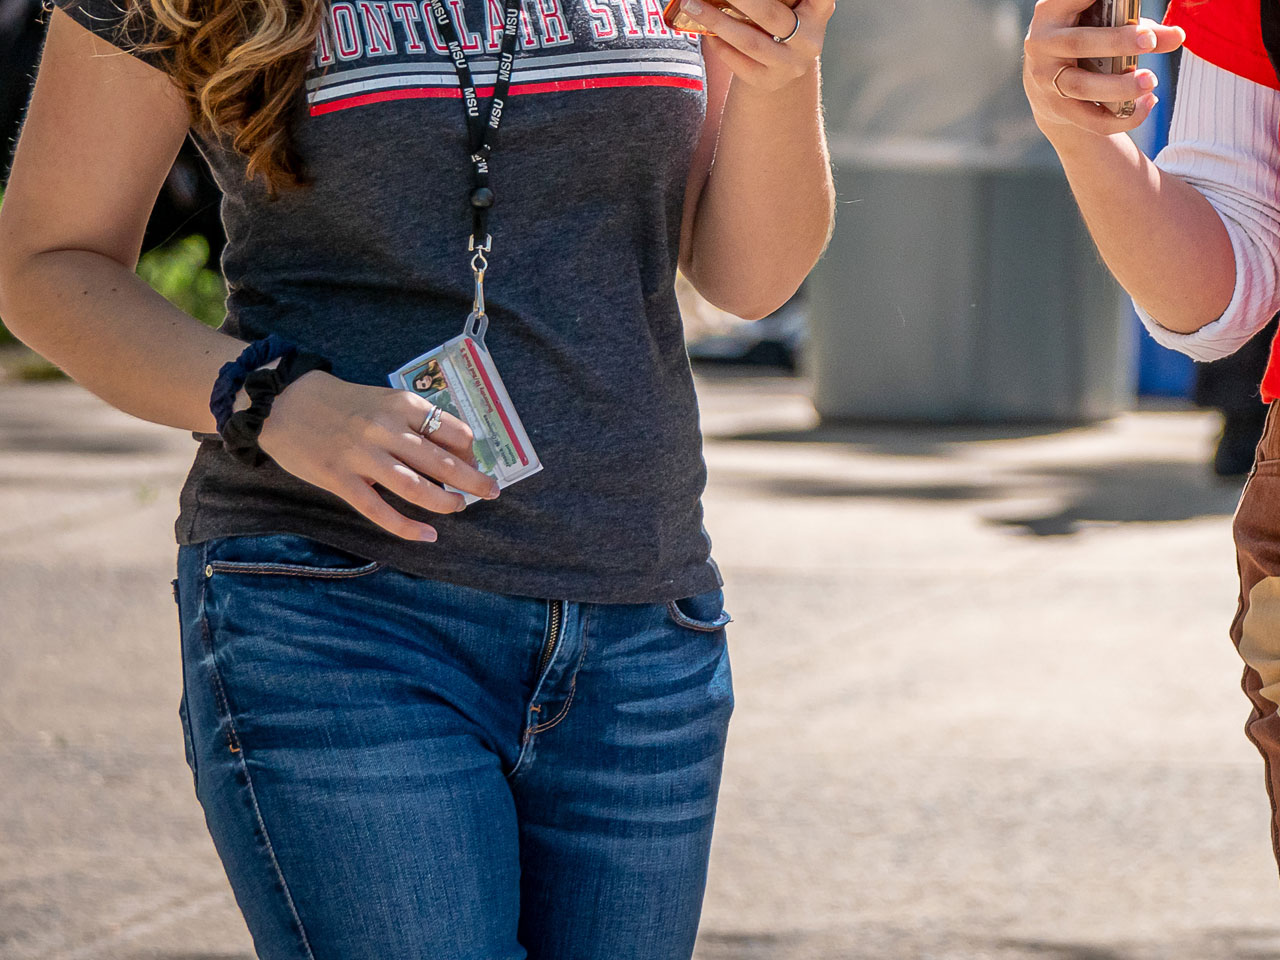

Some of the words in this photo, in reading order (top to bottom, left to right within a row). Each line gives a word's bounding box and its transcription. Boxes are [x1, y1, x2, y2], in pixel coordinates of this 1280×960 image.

[505, 8, 519, 35] MSU
[449, 41, 467, 69] MSU
[464, 87, 479, 117] MSU
[500, 52, 513, 81] MSU
[489, 98, 504, 129] MSU
